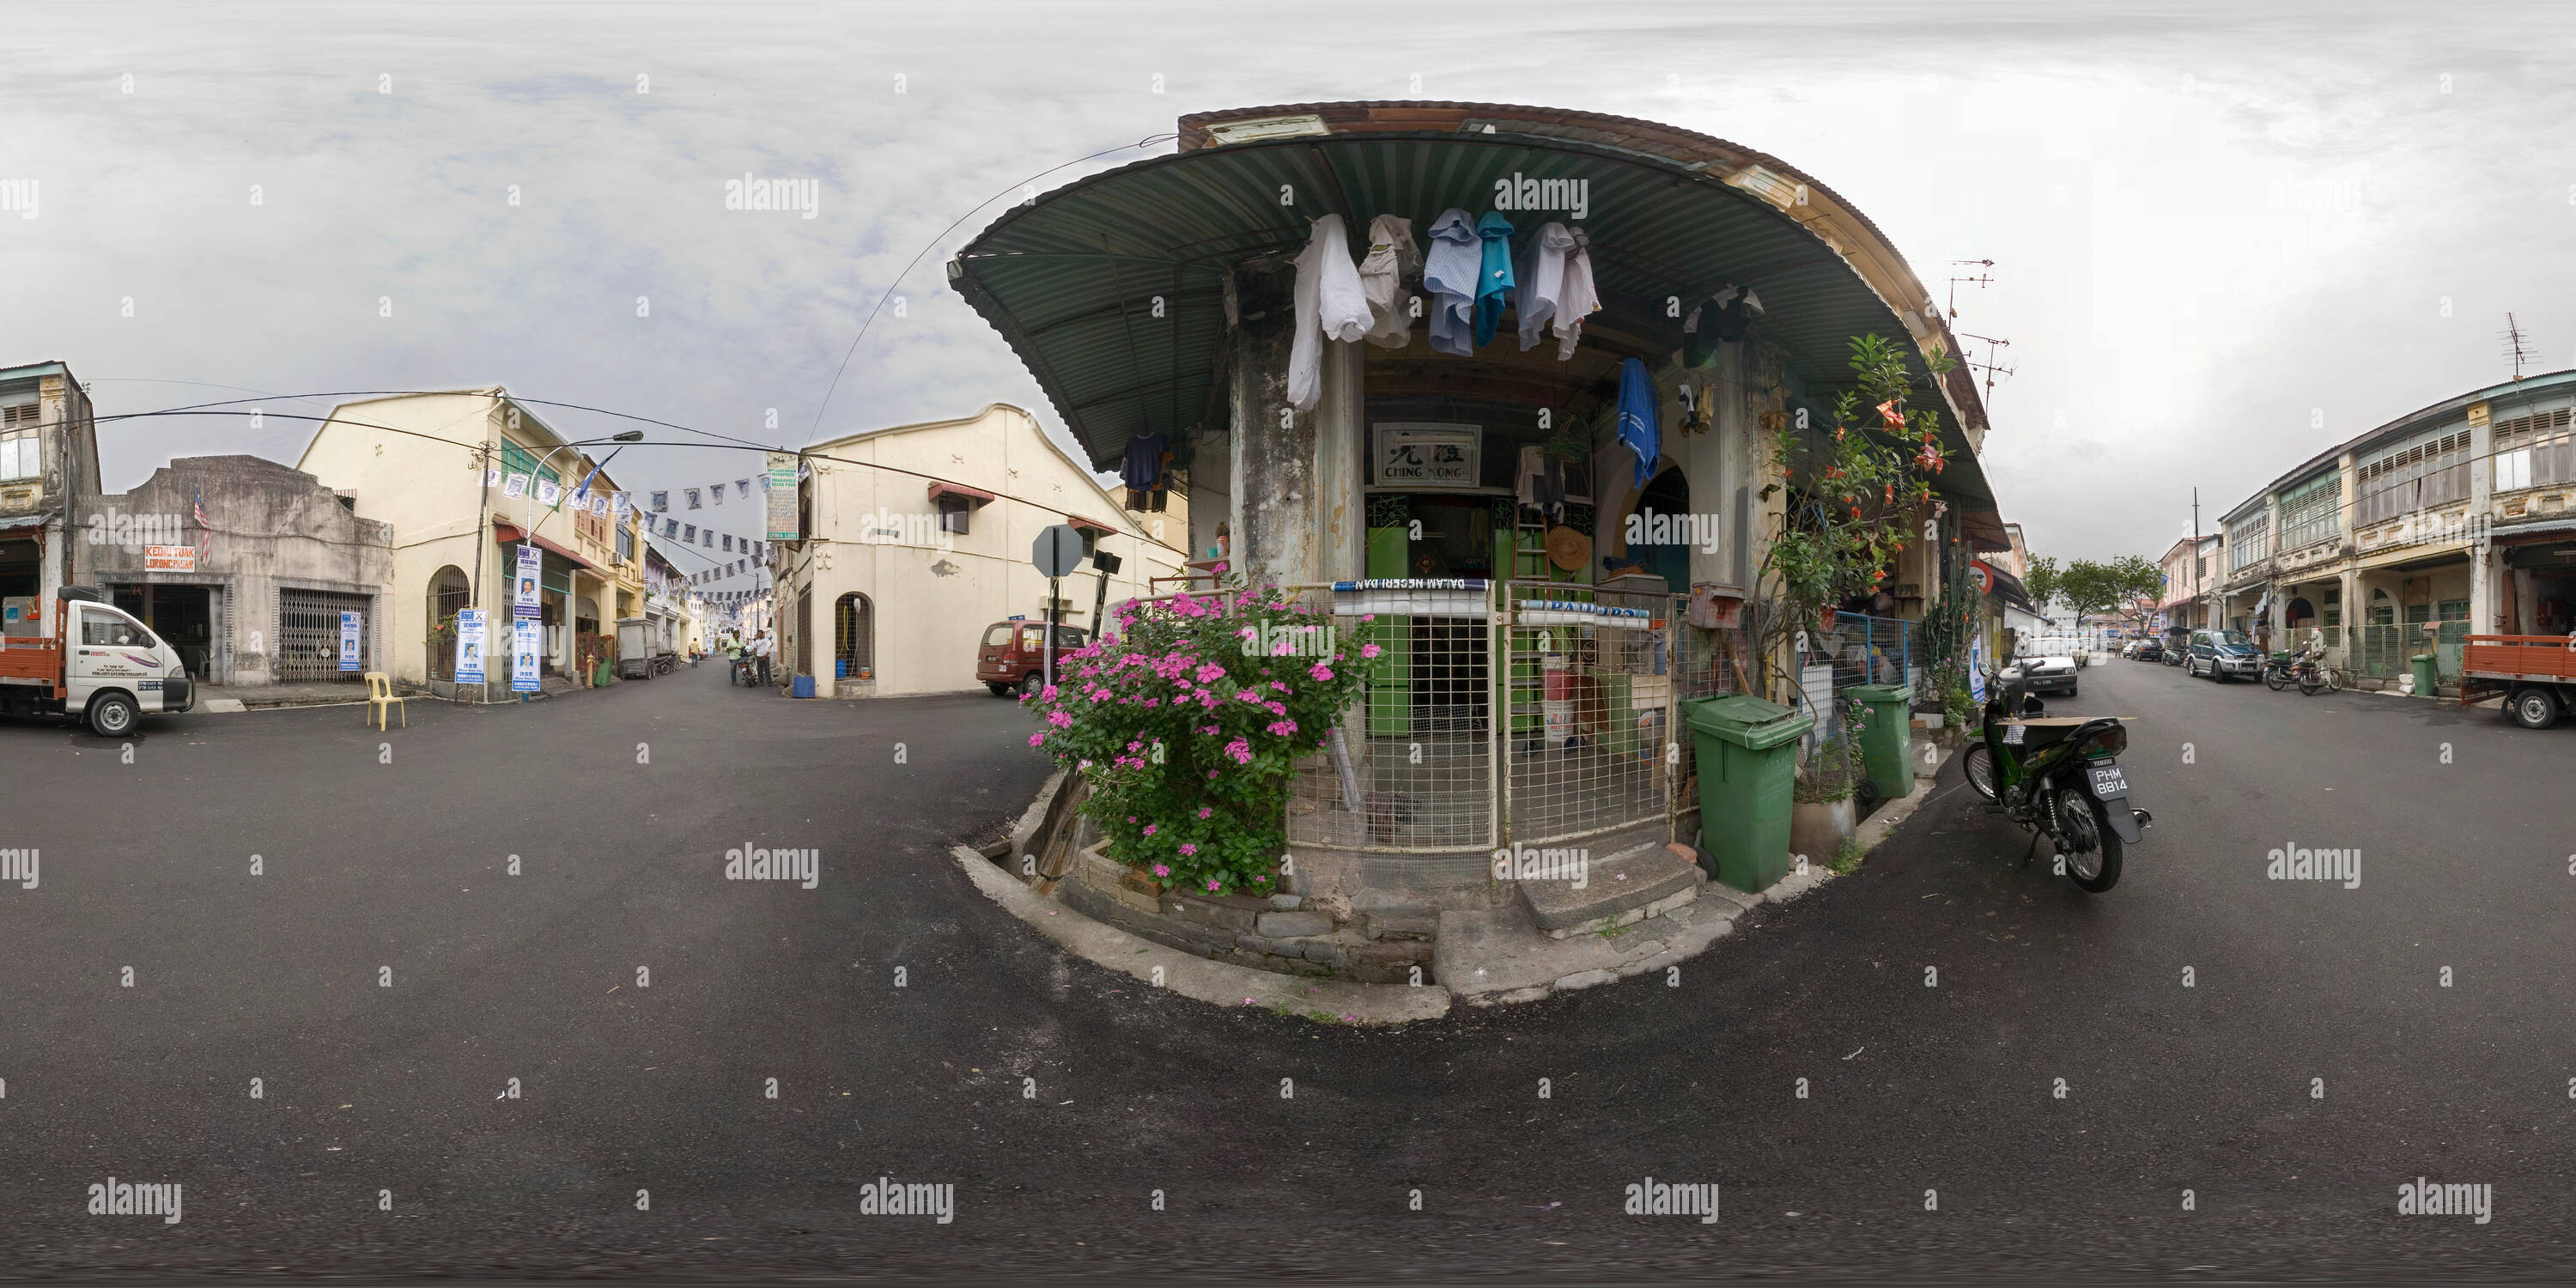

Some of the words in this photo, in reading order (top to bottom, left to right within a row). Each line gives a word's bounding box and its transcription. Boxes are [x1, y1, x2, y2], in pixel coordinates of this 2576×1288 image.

[1385, 467, 1423, 477] CHING
[1429, 467, 1461, 478] KONG
[145, 546, 172, 557] KEDAI
[1355, 579, 1378, 591] DAN
[1382, 578, 1424, 590] NEGERI
[1427, 578, 1465, 590] DALAM
[2096, 768, 2122, 781] PHM
[2097, 779, 2127, 794] 8814
